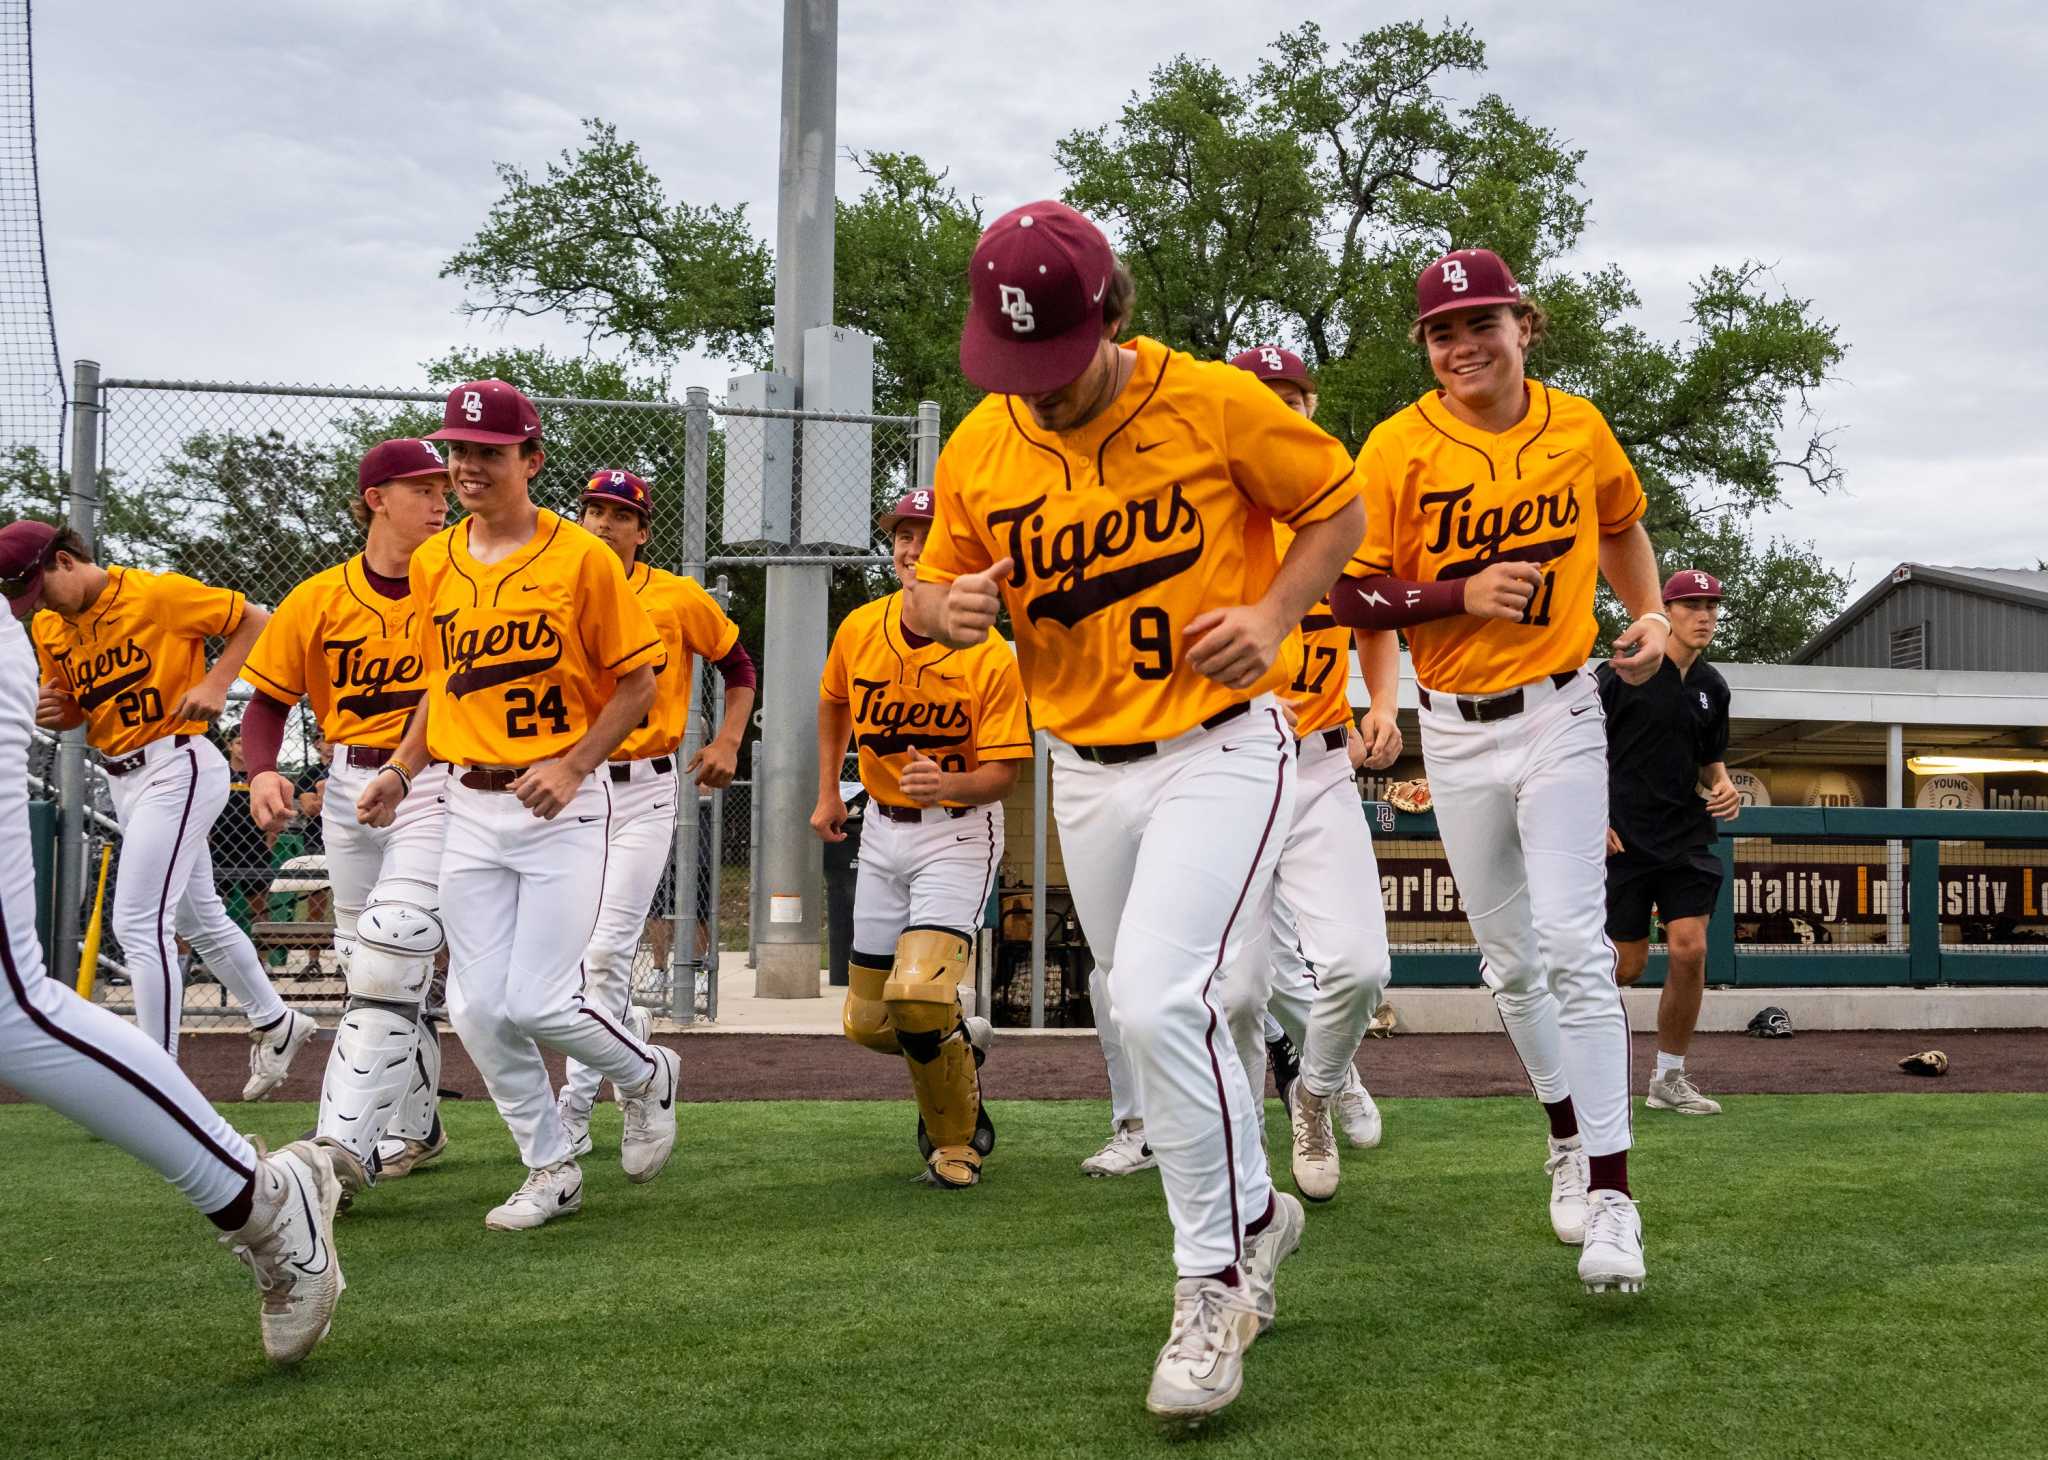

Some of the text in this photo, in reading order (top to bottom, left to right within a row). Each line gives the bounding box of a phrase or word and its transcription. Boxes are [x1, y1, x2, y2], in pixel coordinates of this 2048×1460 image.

[1441, 260, 1469, 293] DS
[998, 283, 1035, 333] DS
[1260, 347, 1283, 371] DS
[461, 391, 483, 423] DS
[986, 482, 1197, 592] Tigers
[1419, 482, 1580, 561] Tigers
[433, 607, 557, 674] Tigers
[1130, 607, 1174, 681] 9
[44, 638, 145, 696] Tigers
[323, 636, 424, 697] Tige
[1291, 644, 1338, 694] 17
[115, 687, 165, 728] 20
[504, 685, 571, 739] 24
[853, 678, 968, 737] Tigers
[1934, 778, 1969, 792] YOUNG
[1381, 868, 1466, 912] arle
[1733, 871, 1841, 922] ntality
